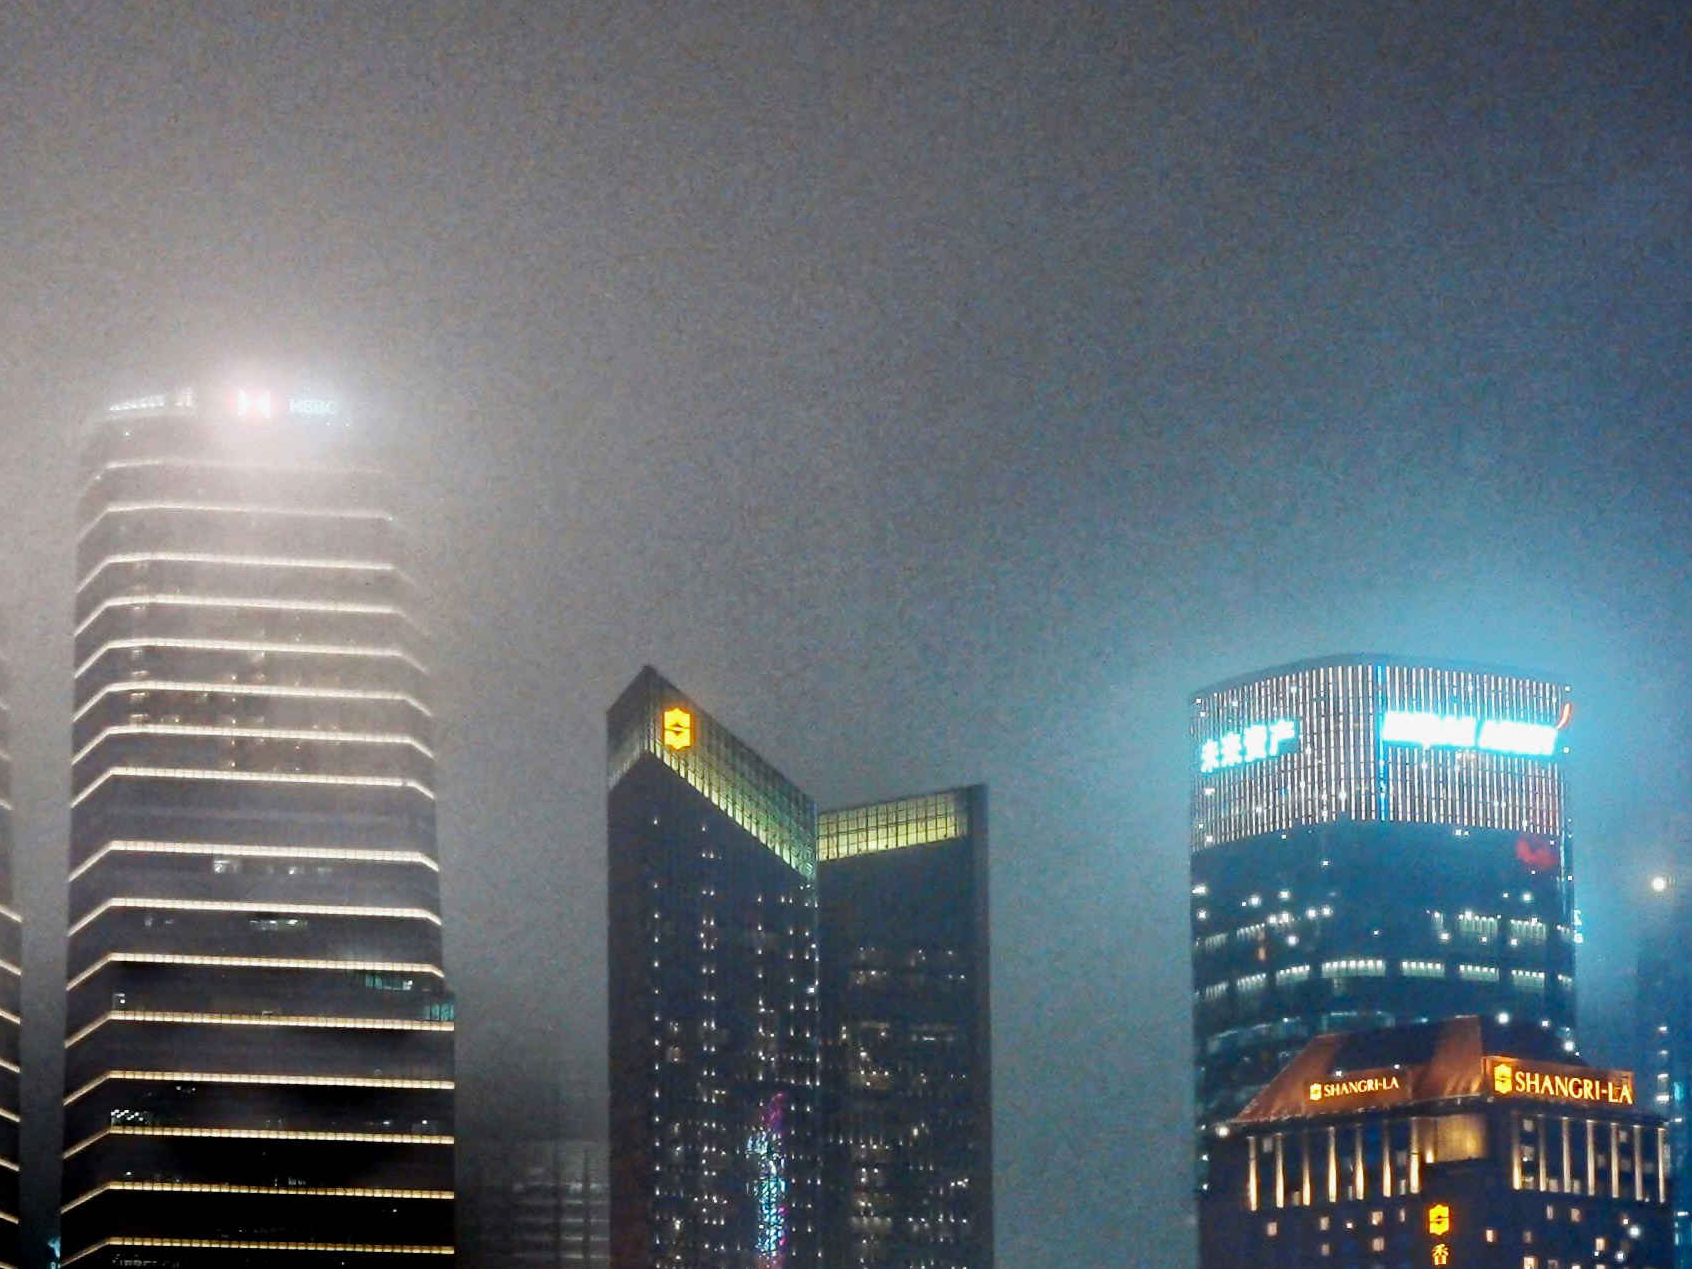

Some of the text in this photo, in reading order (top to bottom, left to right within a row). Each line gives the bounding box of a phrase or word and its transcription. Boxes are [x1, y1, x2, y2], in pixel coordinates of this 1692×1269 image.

[290, 398, 338, 415] HSBC
[1323, 1077, 1399, 1098] SHANGRI-LA
[1514, 1070, 1633, 1105] SHANGRI-LA
